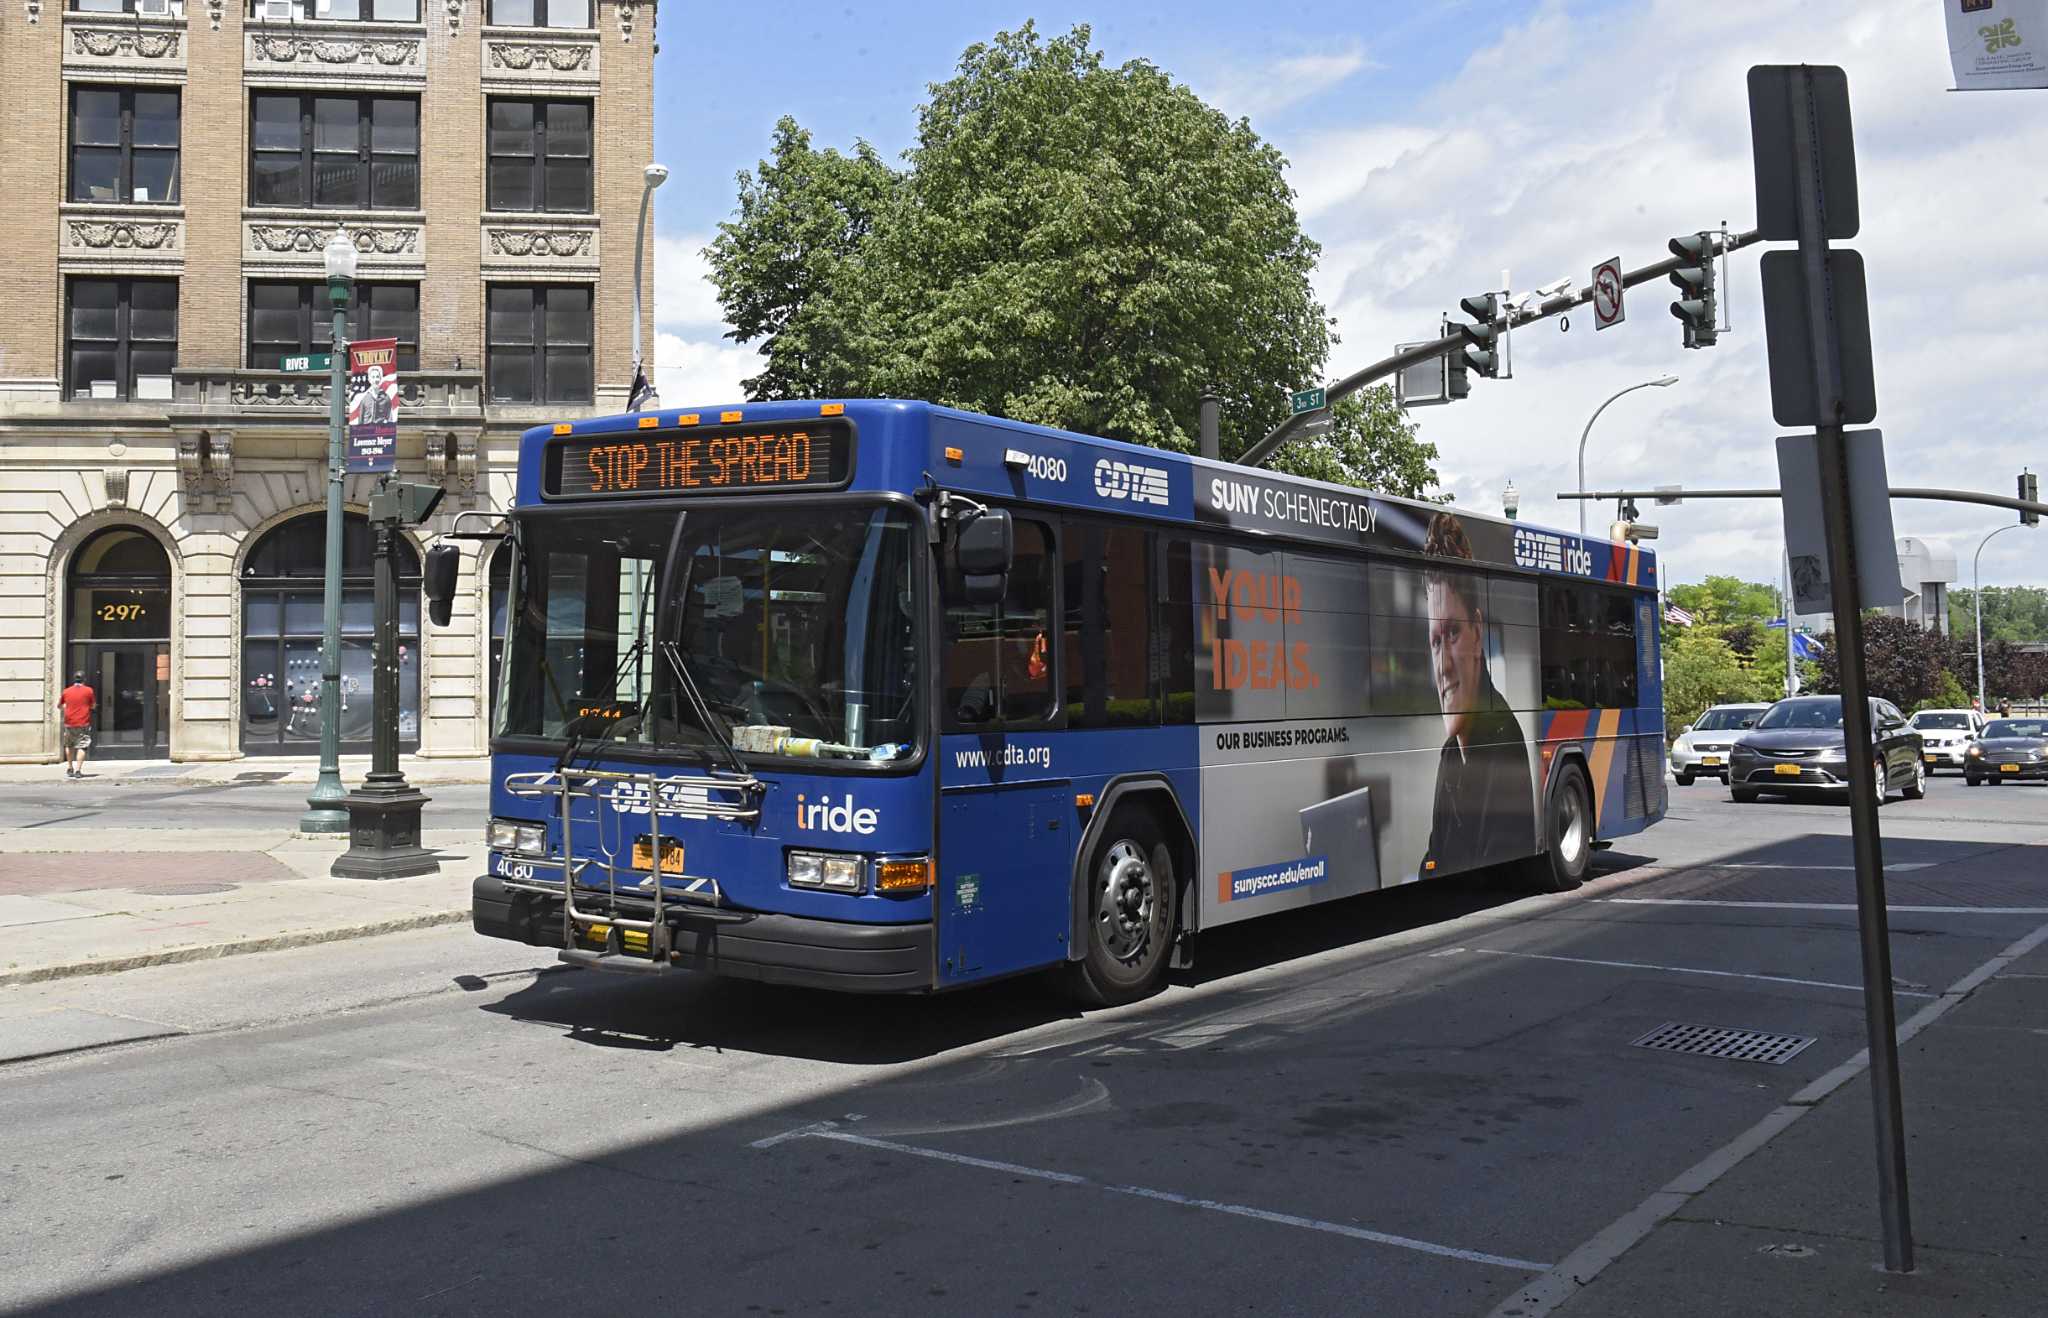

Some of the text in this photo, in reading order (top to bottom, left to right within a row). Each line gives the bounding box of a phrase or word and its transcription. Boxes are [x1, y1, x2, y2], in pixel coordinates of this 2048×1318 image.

[285, 357, 309, 371] RIVER
[1310, 392, 1320, 406] ST
[588, 433, 810, 490] STOP THE SPREAD
[1027, 454, 1067, 482] 4080
[1094, 458, 1169, 506] CDTA
[1211, 478, 1378, 533] SUNY SCHENECTADY
[1514, 529, 1592, 576] CDTA iride
[1209, 567, 1303, 625] YOUR
[1212, 638, 1320, 690] IDEAS.
[955, 743, 1051, 769] www.cdta.org
[1216, 726, 1350, 750] OUR BUSINESS PROGRAMS.
[797, 793, 879, 834] iride
[496, 858, 534, 880] 4080
[1234, 860, 1325, 894] sunysccc.edu/enroll
